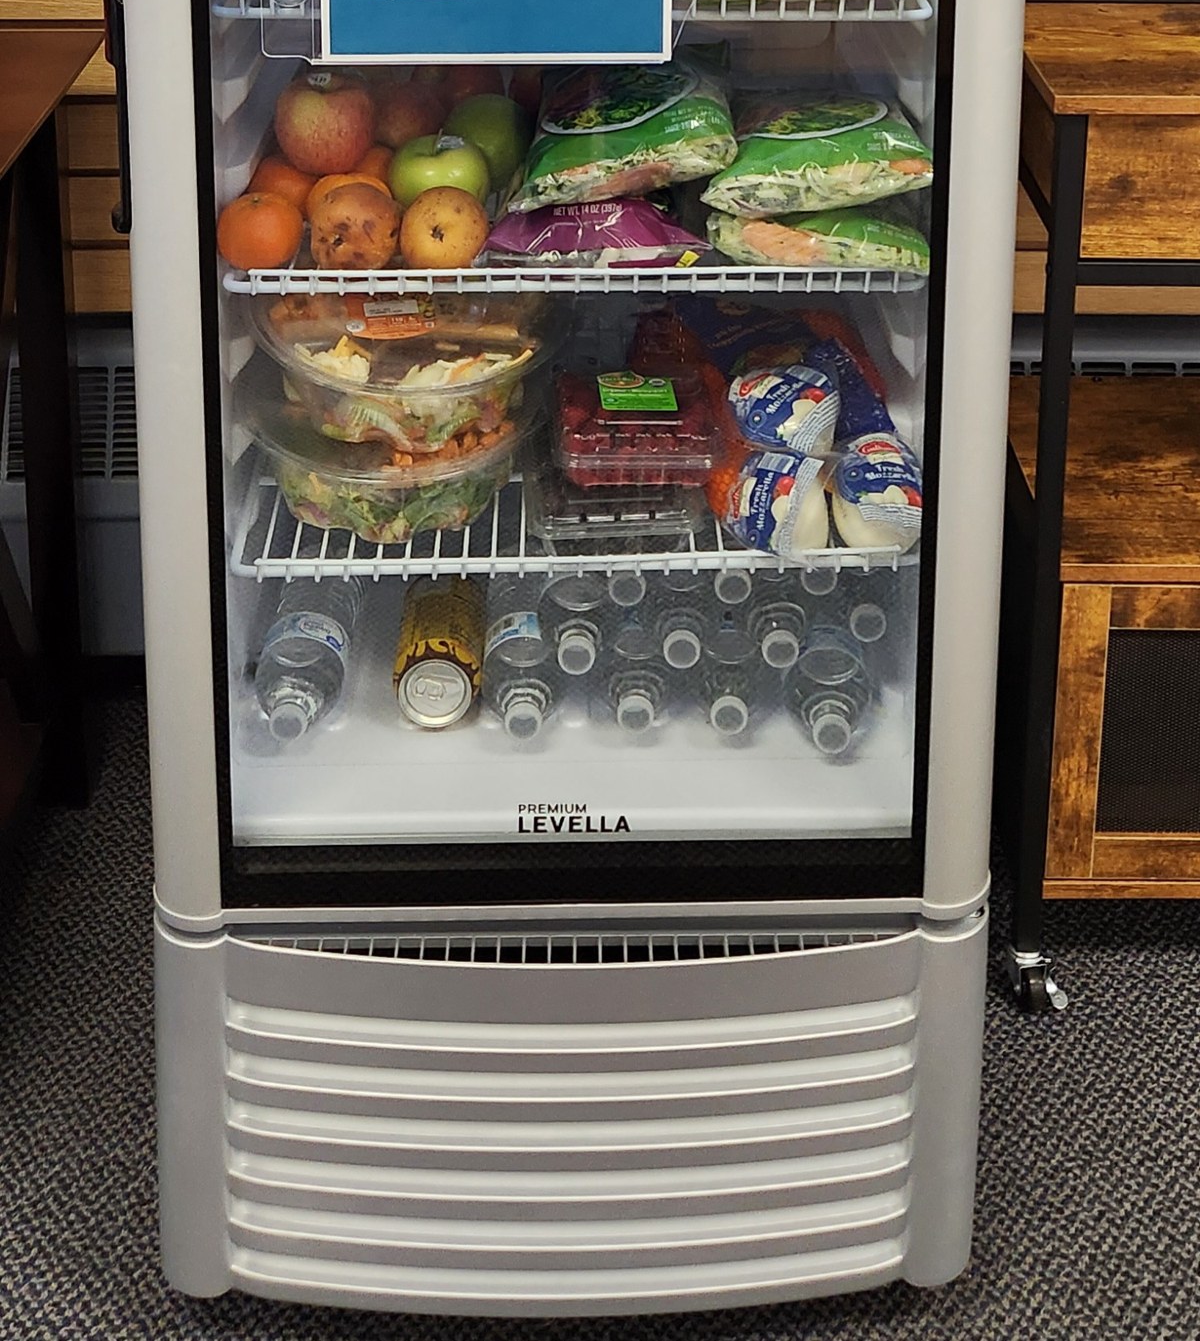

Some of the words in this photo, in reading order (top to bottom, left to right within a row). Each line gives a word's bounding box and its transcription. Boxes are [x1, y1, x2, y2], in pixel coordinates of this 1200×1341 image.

[553, 206, 566, 216] NET
[581, 205, 589, 214] 14
[590, 204, 600, 214] OZ
[757, 472, 775, 530] Mozzarella
[518, 804, 587, 814] PREMIUM
[518, 816, 631, 833] LEVELLA
